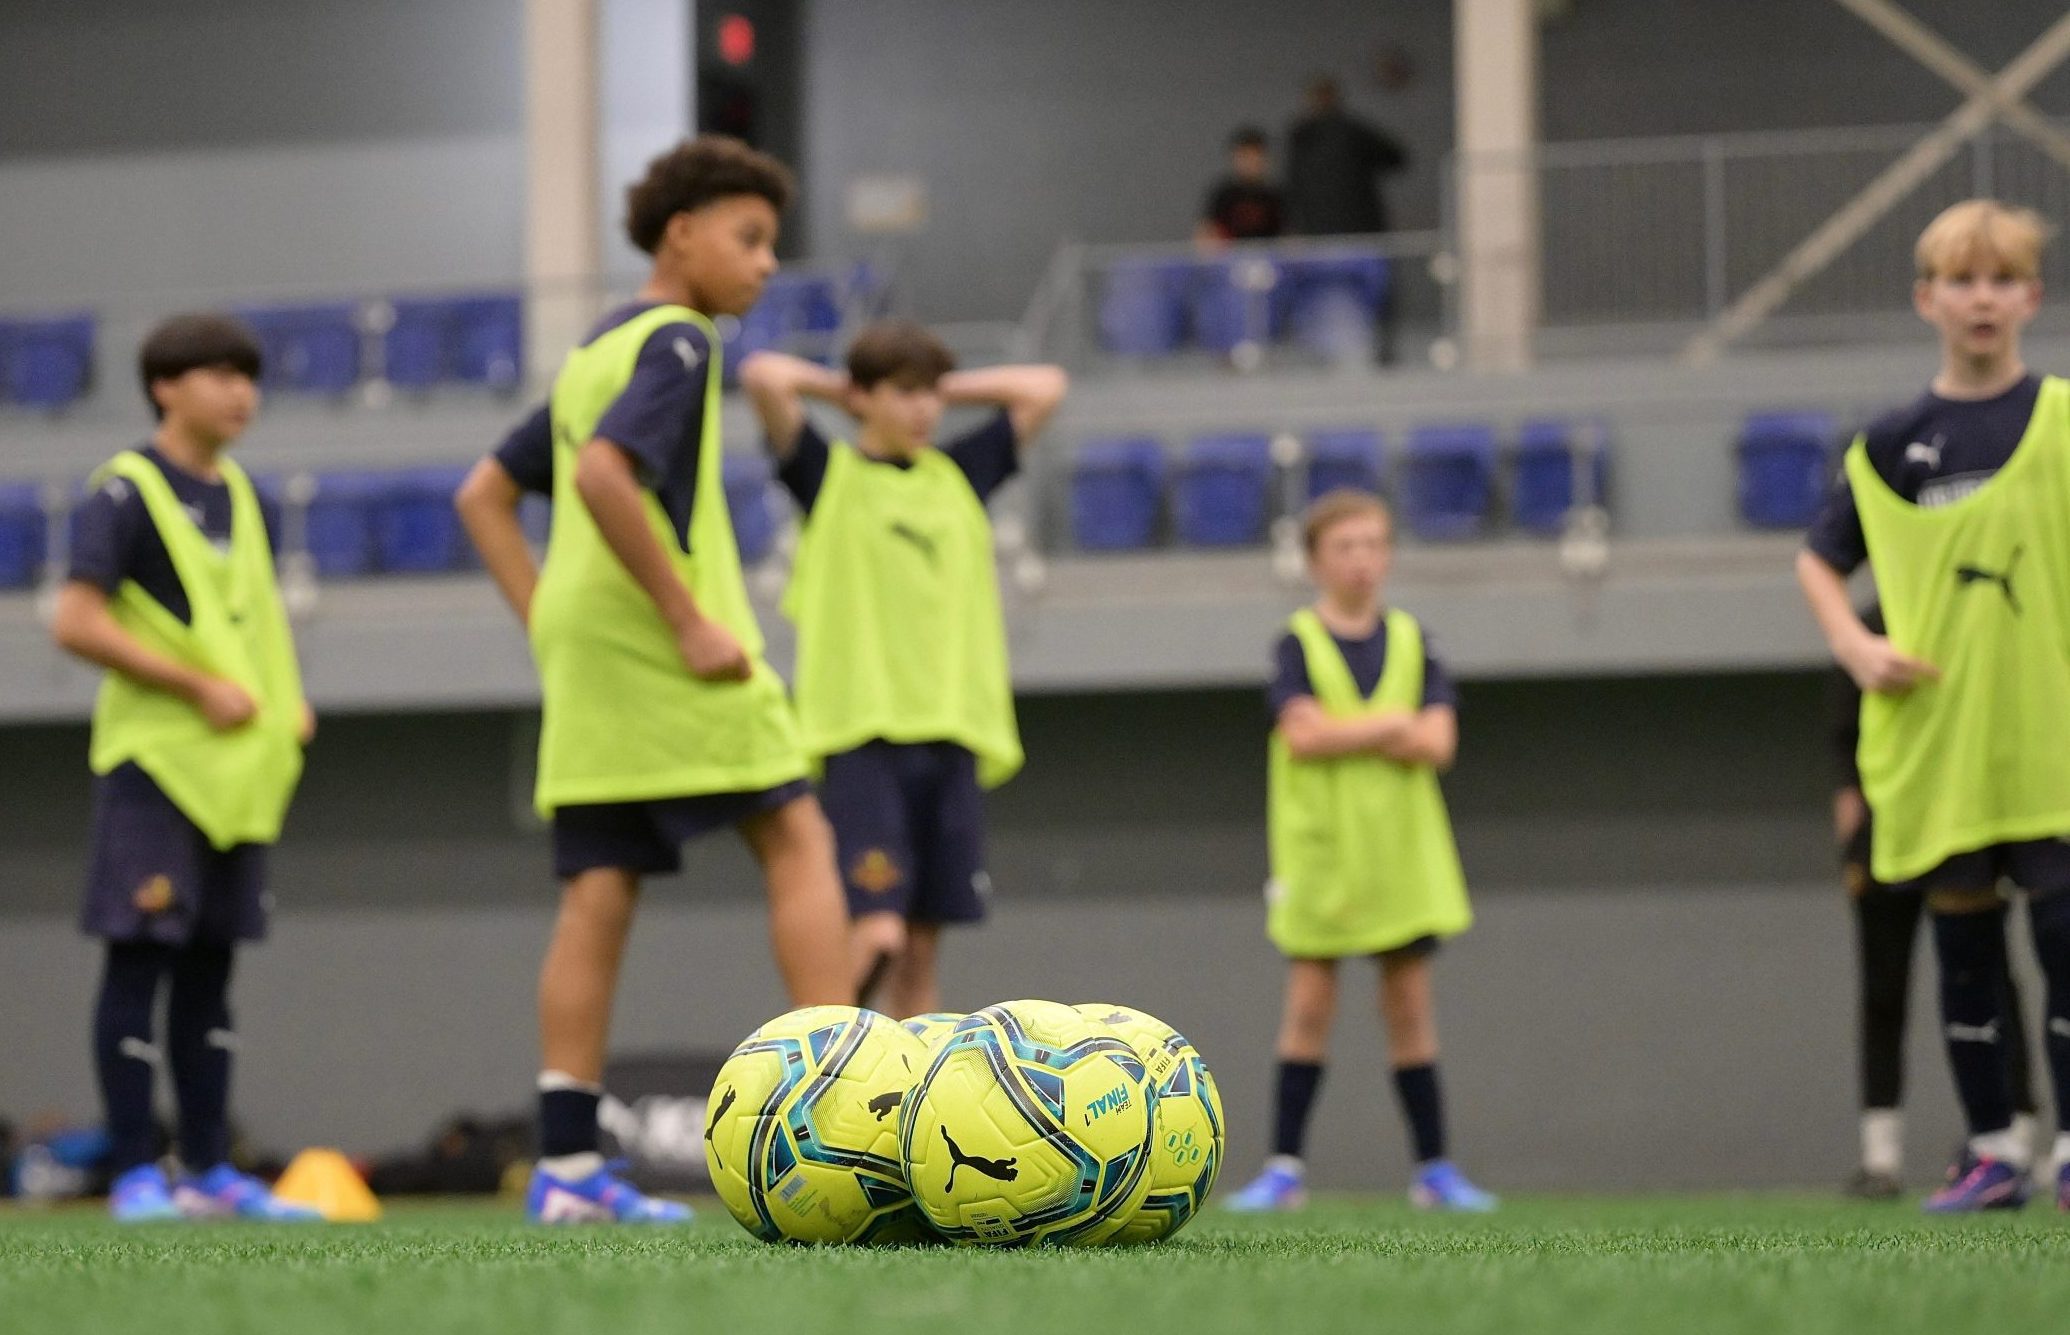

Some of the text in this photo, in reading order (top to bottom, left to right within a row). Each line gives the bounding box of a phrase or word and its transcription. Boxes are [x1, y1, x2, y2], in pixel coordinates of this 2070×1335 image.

[1155, 1056, 1171, 1074] FIFA
[1084, 1082, 1129, 1127] FINAL 1
[1115, 1100, 1132, 1116] TEAM
[983, 1228, 1010, 1238] FIFA
